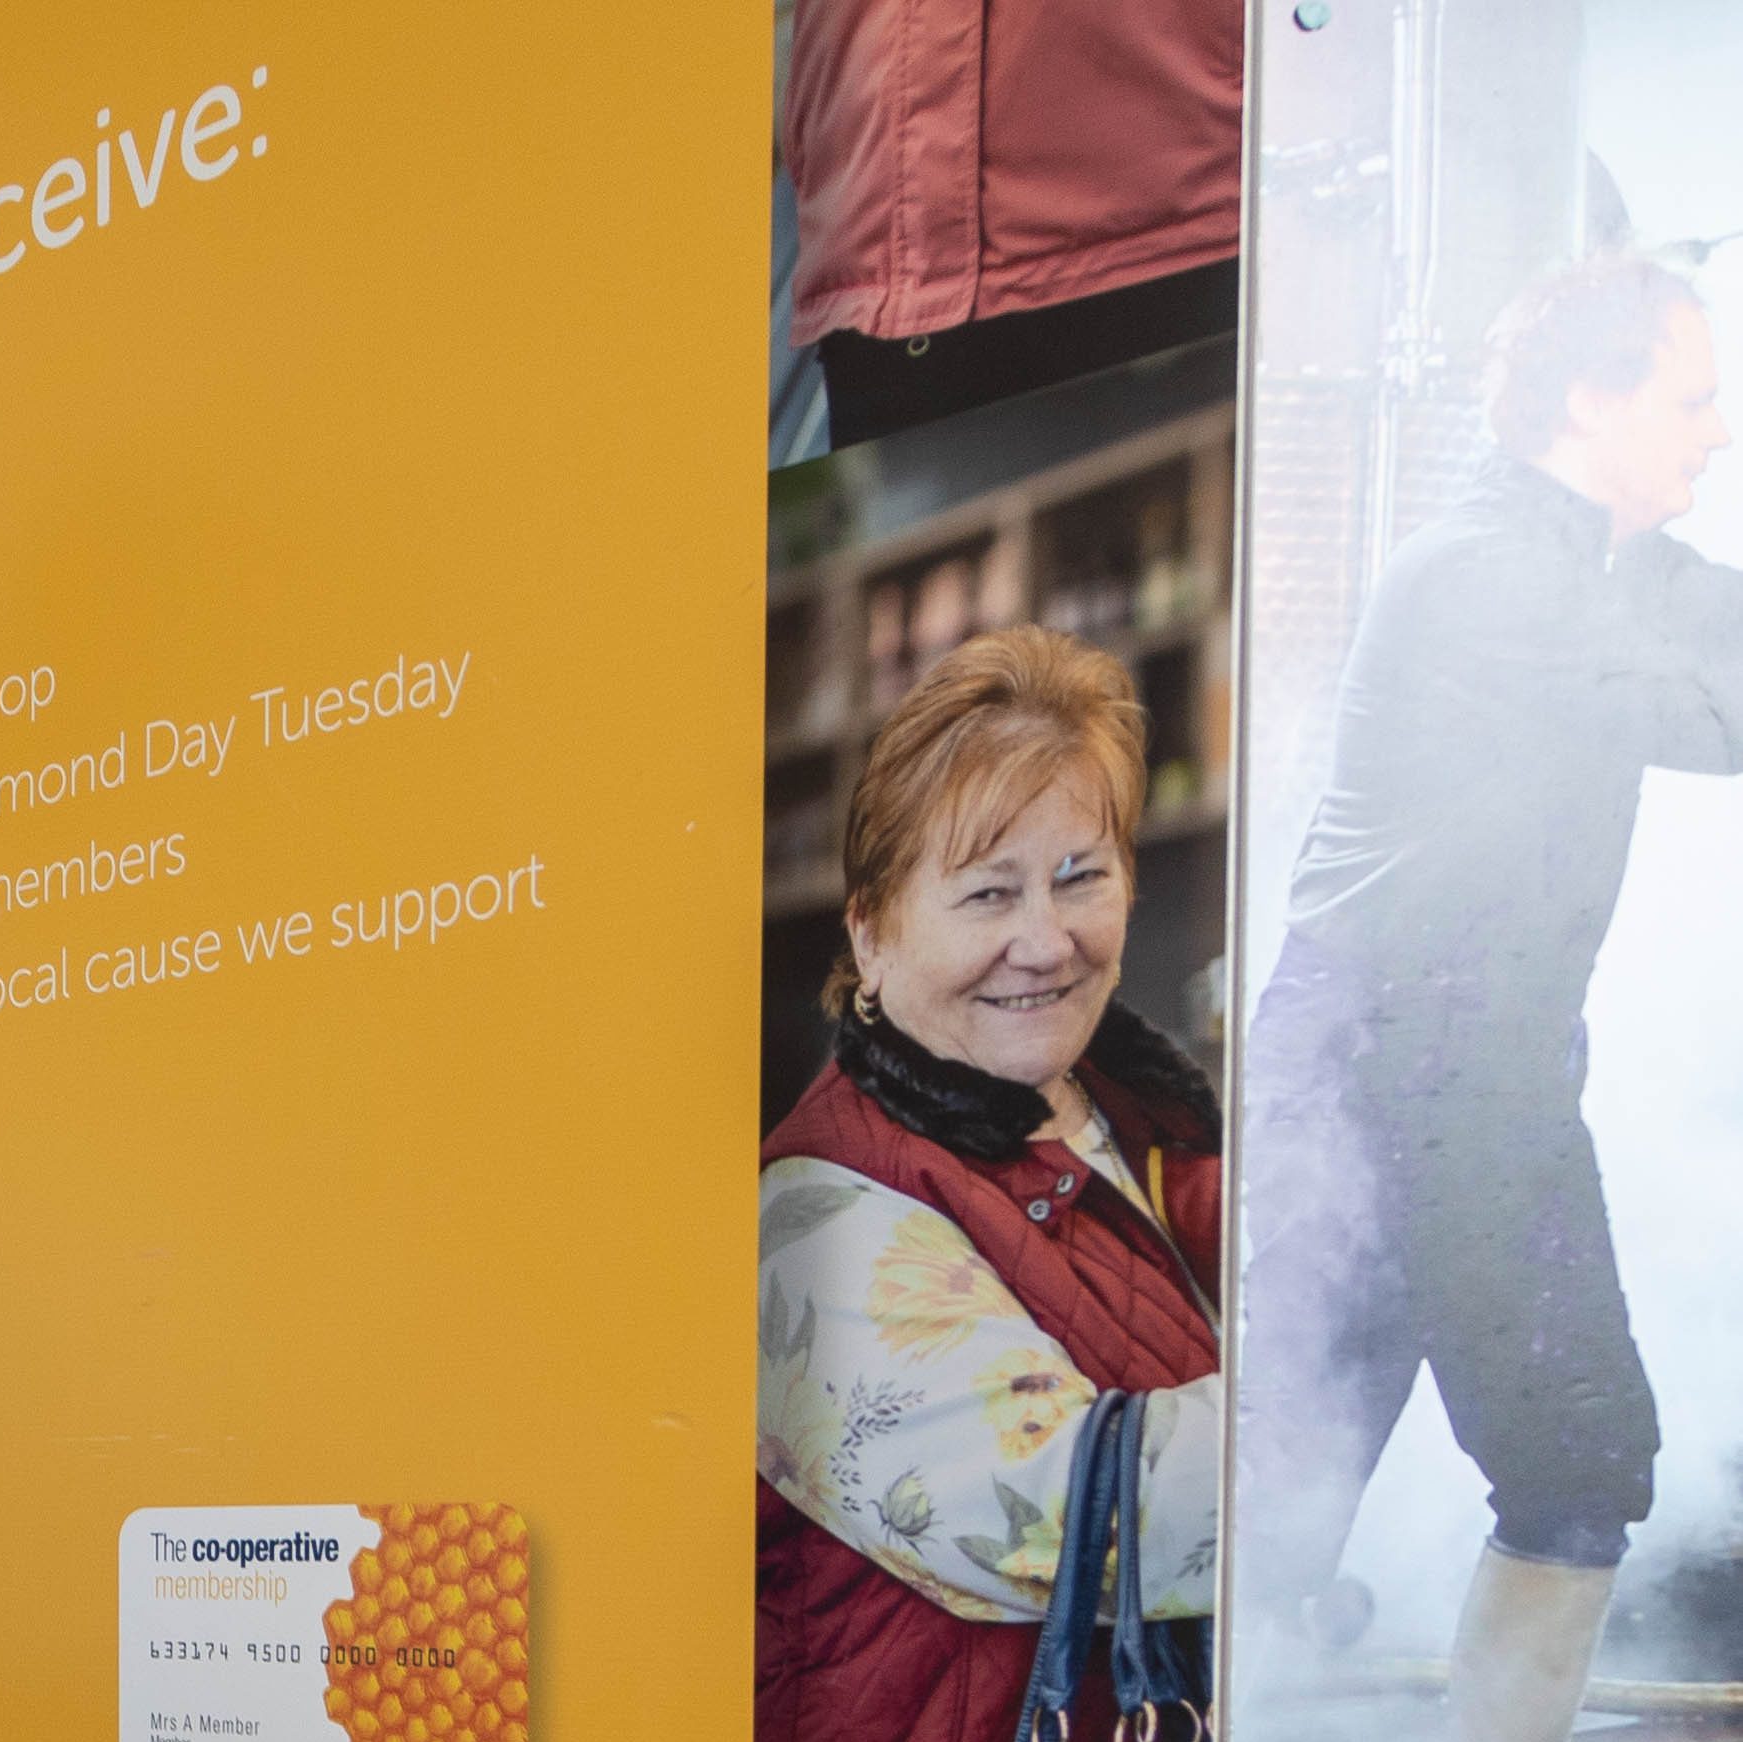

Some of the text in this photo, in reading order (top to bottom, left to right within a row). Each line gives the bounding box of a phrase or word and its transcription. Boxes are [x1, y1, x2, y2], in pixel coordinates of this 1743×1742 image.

[144, 716, 237, 778] Day
[249, 650, 472, 748] Tuesday
[83, 929, 222, 995] cause
[235, 911, 313, 965] we
[330, 853, 547, 951] support
[150, 1531, 340, 1566] The co-operative
[154, 1570, 288, 1608] membership
[149, 1639, 456, 1669] 633174 9500 0000 0000
[150, 1712, 260, 1736] Mrs A Member
